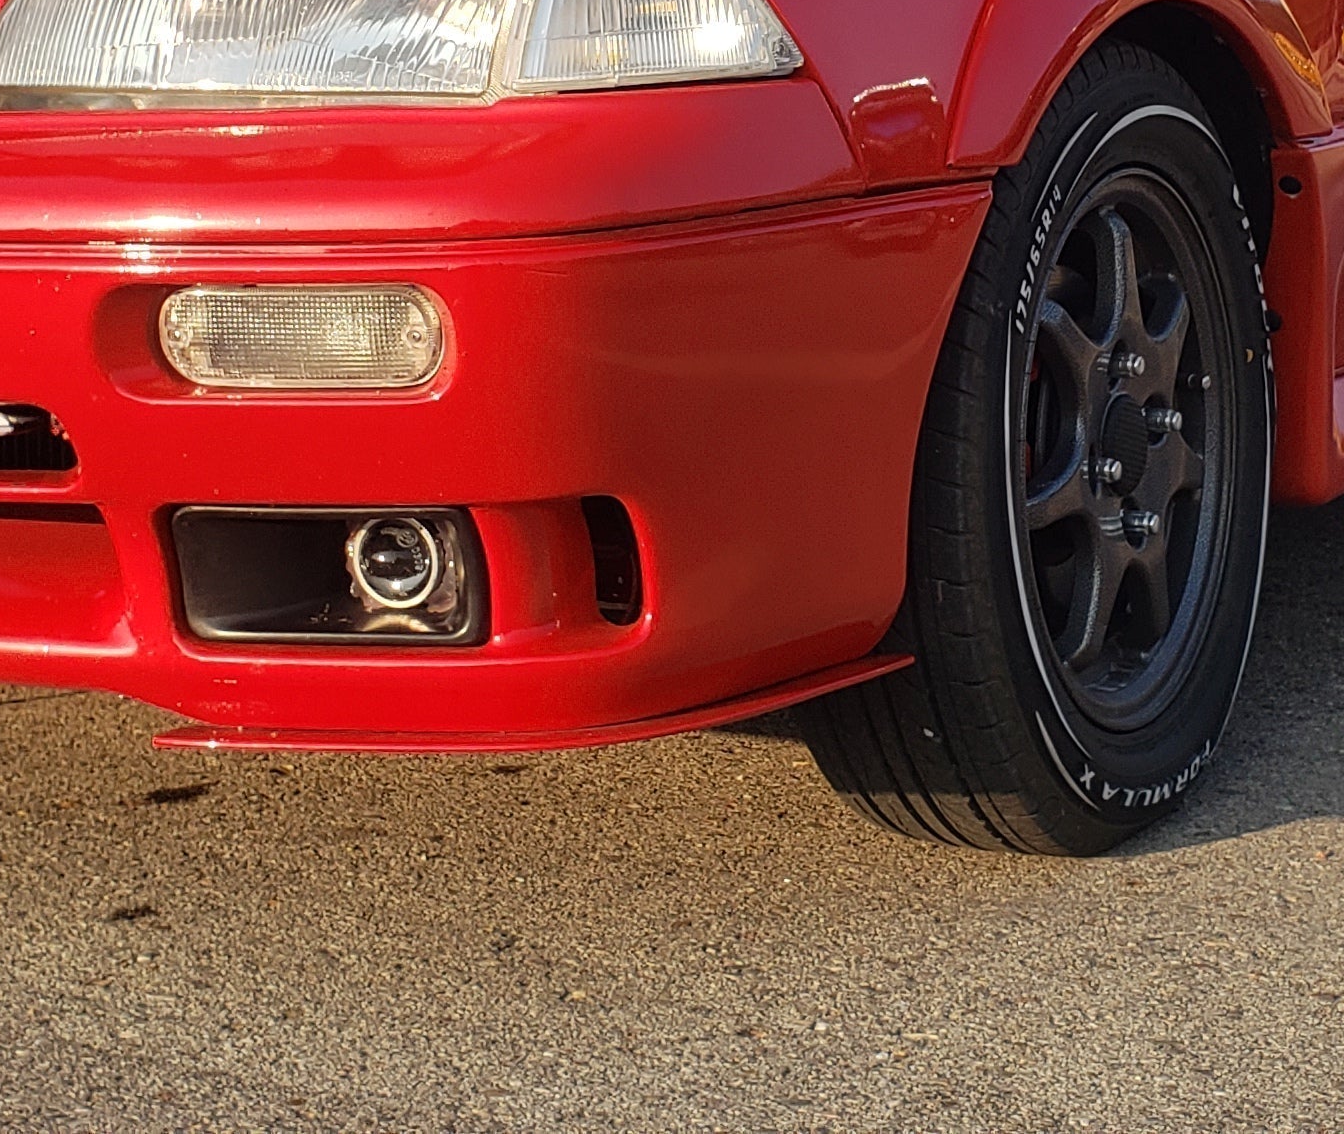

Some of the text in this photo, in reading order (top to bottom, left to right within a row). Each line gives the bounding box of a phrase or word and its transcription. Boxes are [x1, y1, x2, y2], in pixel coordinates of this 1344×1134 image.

[1015, 184, 1061, 335] 175/65R14
[1079, 738, 1212, 807] FORMULA X
